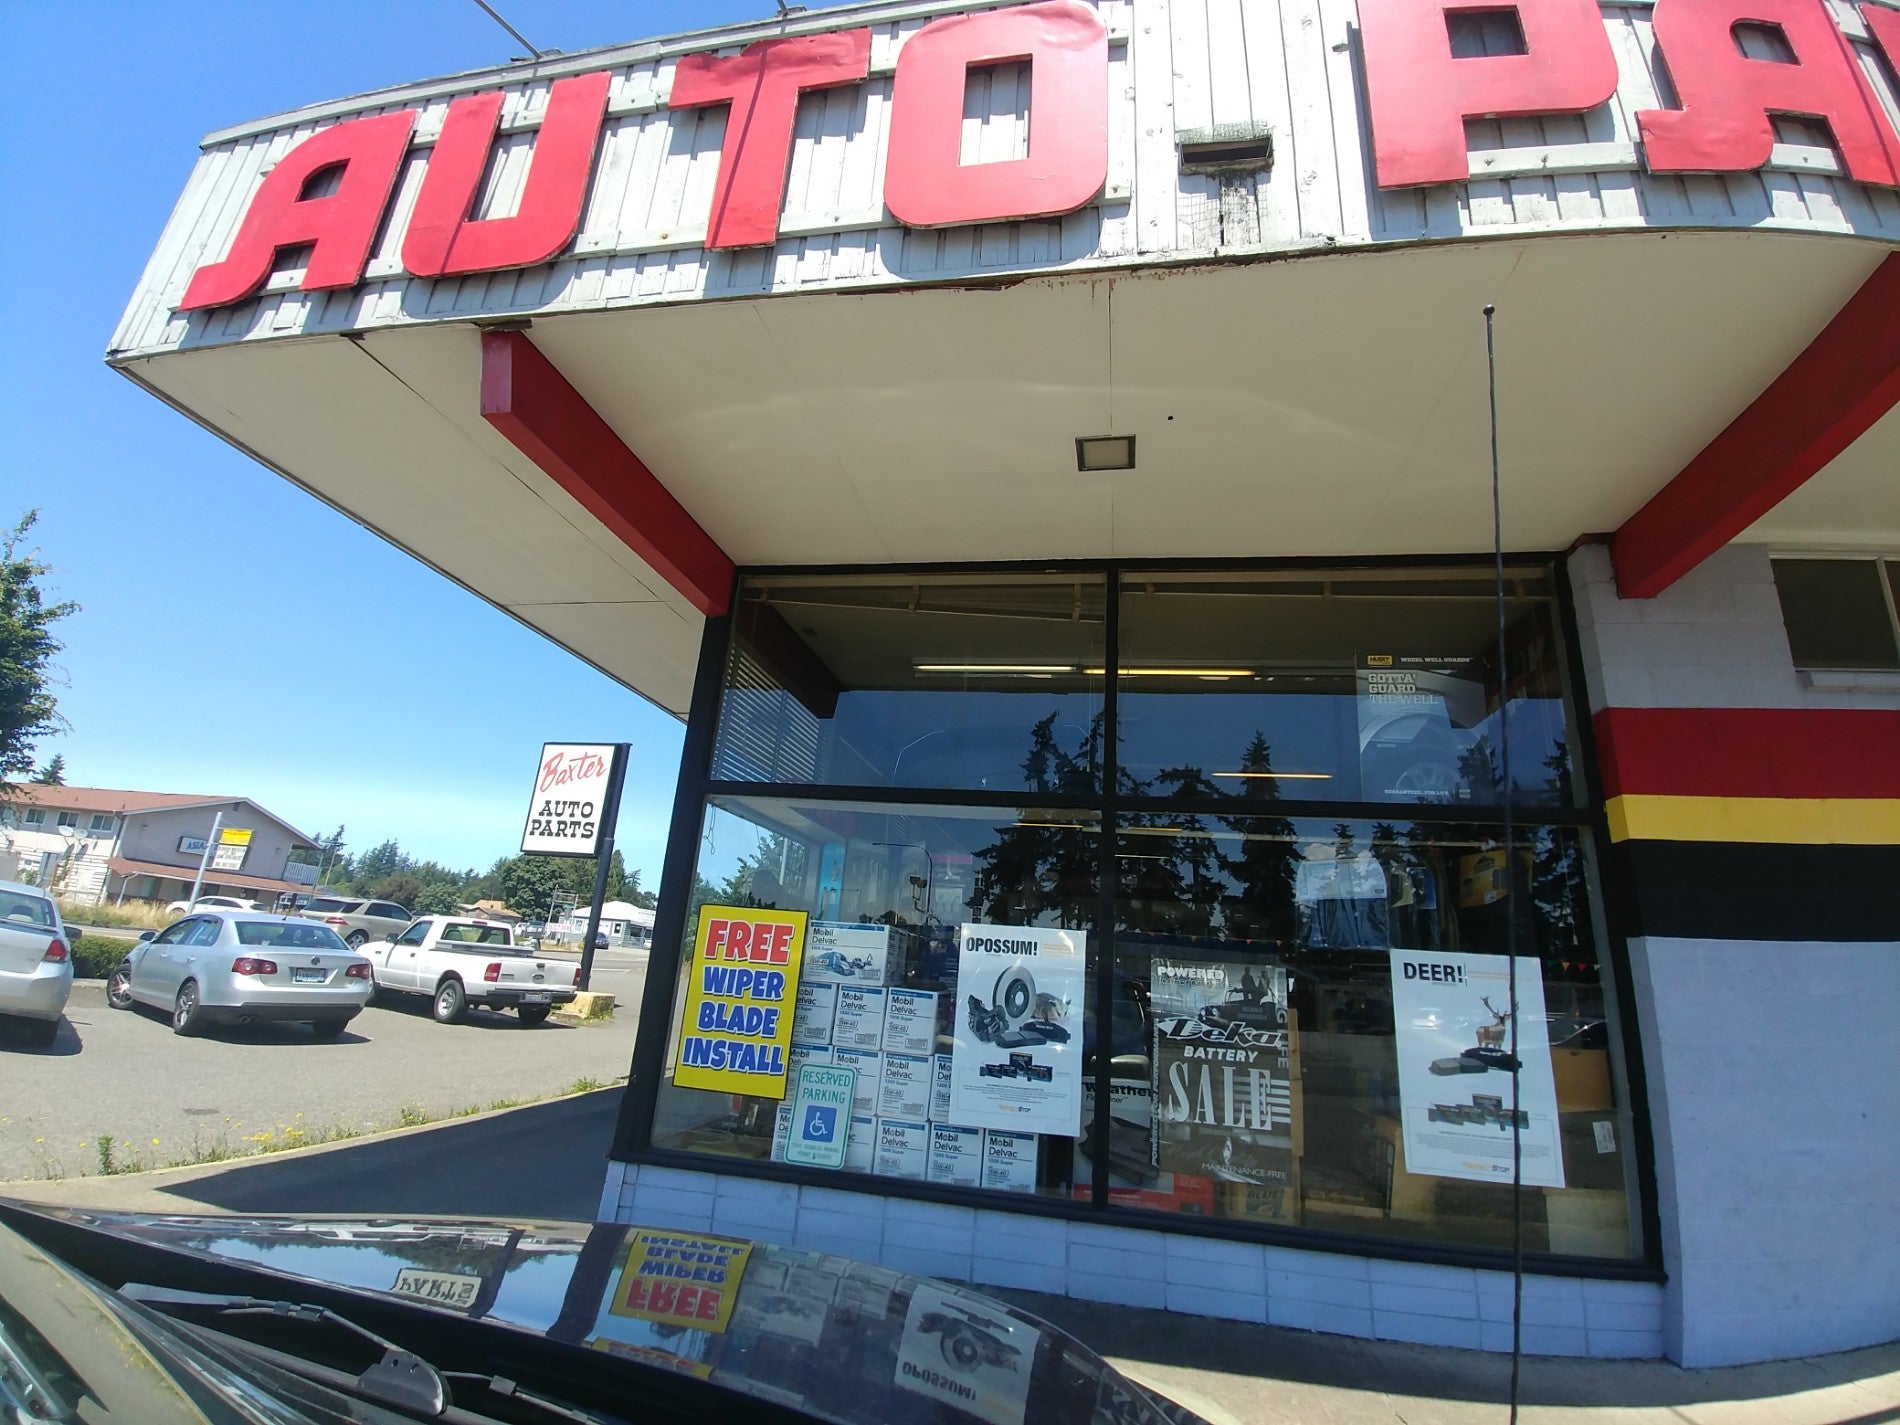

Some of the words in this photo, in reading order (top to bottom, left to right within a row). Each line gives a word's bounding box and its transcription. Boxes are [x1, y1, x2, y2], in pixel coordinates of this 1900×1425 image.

[181, 0, 1109, 309] AUTO
[1356, 0, 1900, 188] PA
[1368, 684, 1416, 694] GUARD
[1369, 694, 1396, 704] THE
[539, 751, 607, 793] Baxter
[538, 800, 594, 818] AUTO
[529, 819, 595, 839] PARTS
[812, 928, 834, 937] Mobil
[704, 919, 796, 965] FREE
[812, 936, 837, 945] Delvac
[965, 937, 1038, 956] OPOSSUM!
[1157, 966, 1225, 980] POWERED
[1403, 962, 1464, 983] DEER!
[703, 966, 785, 1000] WIPER
[799, 987, 814, 997] obil
[841, 992, 864, 1001] Mobil
[840, 1001, 867, 1010] Delvac
[891, 996, 914, 1006] Mobil
[890, 1005, 918, 1015] Delvac
[697, 1001, 780, 1038] BLADE
[1158, 1016, 1281, 1047] Deka
[682, 1037, 785, 1076] INSTALL
[790, 1049, 810, 1058] Mobil
[837, 1054, 860, 1064] Mobil
[1183, 1045, 1259, 1063] BATTERY
[886, 1060, 909, 1070] Mobil
[802, 1070, 851, 1087] RESERVED
[885, 1069, 913, 1080] Delvac
[802, 1087, 846, 1104] PARKING
[1169, 1061, 1272, 1131] SALE
[882, 1126, 905, 1138] Mobil
[934, 1132, 959, 1142] Mobil
[881, 1137, 909, 1148] Delvac
[934, 1141, 963, 1153] Delvac
[989, 1137, 1014, 1148] Mobil
[988, 1147, 1018, 1159] Delvac
[1202, 1163, 1287, 1180] MAINTENANCE-FREE
